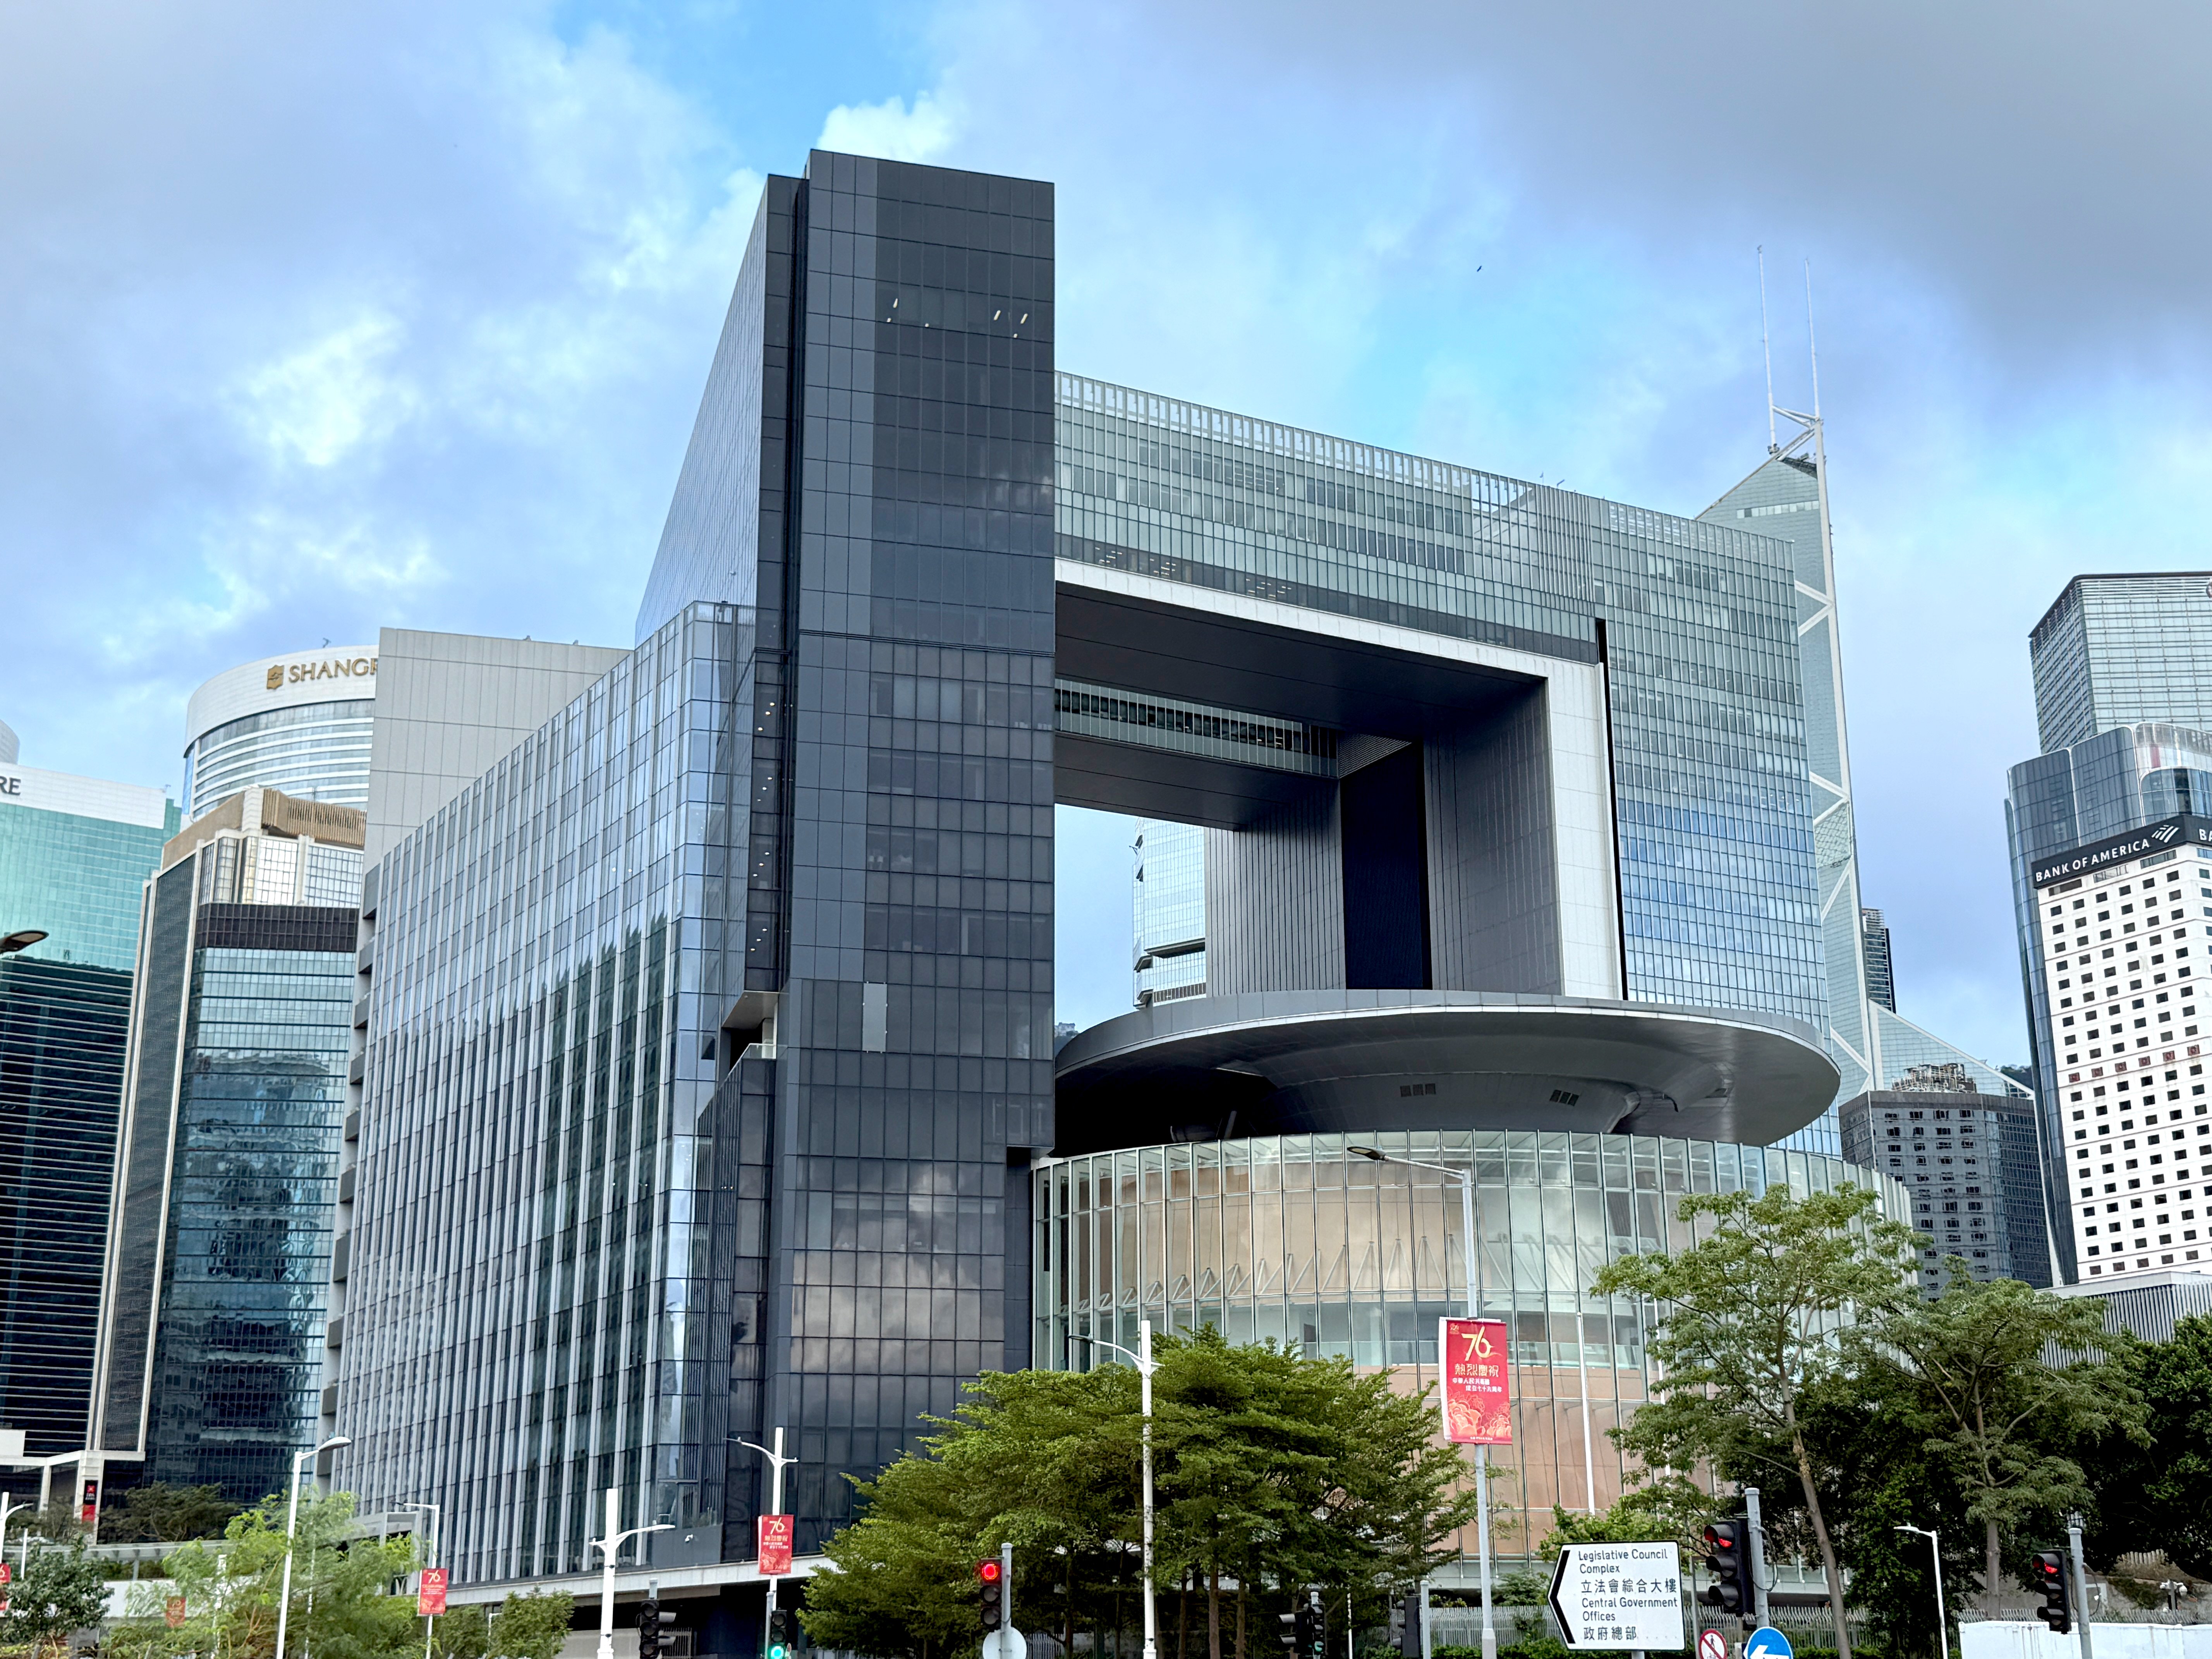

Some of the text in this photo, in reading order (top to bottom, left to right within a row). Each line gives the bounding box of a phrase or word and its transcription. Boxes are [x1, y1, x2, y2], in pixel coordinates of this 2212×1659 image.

[2035, 838, 2150, 882] BANK OF AMERICA
[1461, 1326, 1493, 1362] 76
[769, 1517, 785, 1535] 76
[1578, 1549, 1668, 1562] Legislative Council
[1580, 1563, 1620, 1575] Complex
[428, 1570, 441, 1583] 76
[1581, 1578, 1677, 1594] 立法會綜合大樓
[1582, 1597, 1678, 1607] Central Government
[1583, 1611, 1616, 1621] Offices
[1583, 1626, 1637, 1640] 政府總部
